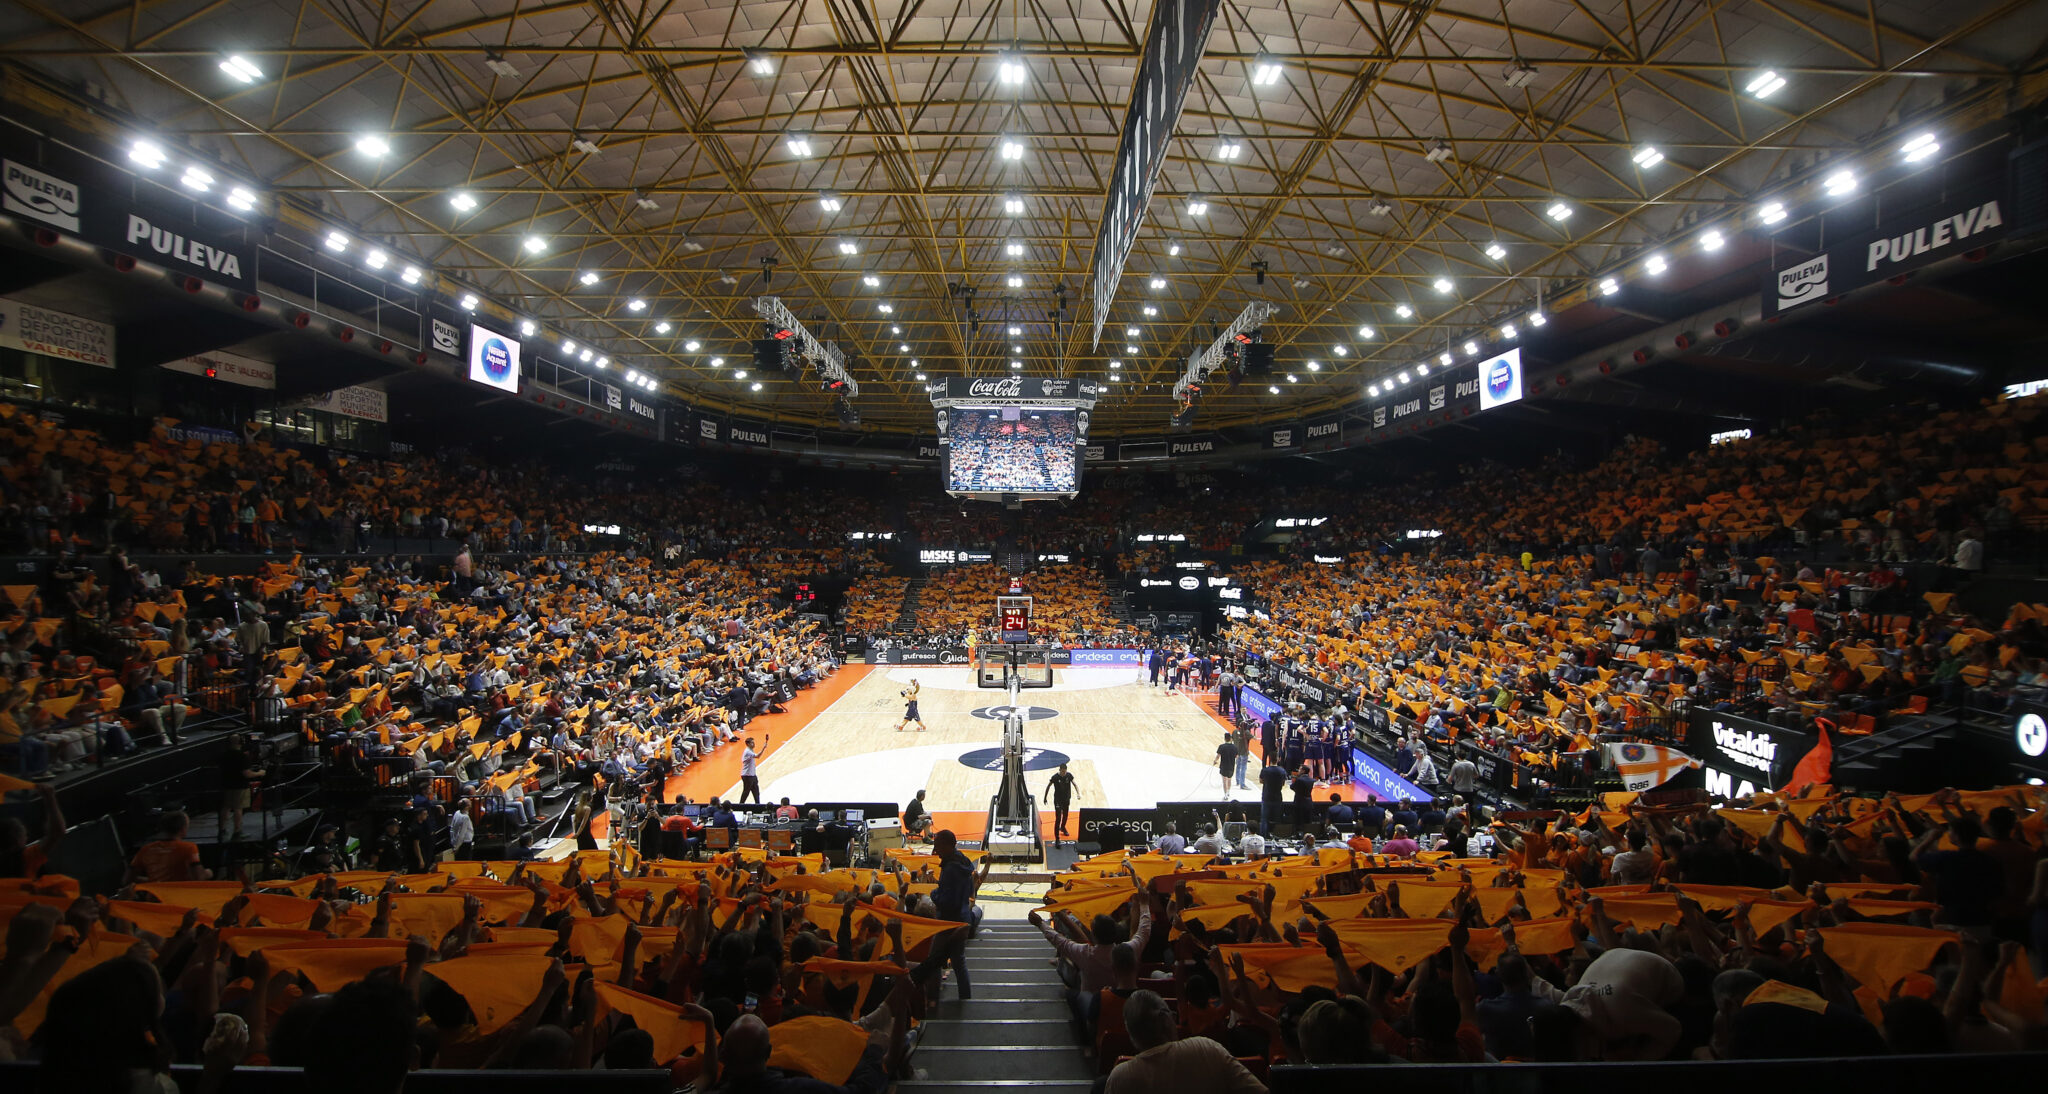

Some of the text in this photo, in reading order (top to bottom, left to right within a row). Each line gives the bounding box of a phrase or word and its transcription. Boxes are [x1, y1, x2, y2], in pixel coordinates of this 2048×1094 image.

[8, 166, 75, 203] PULEVA
[1867, 200, 2002, 271] PULEVA
[127, 213, 242, 279] PULEVA
[1781, 262, 1824, 287] PULEVA
[20, 318, 106, 346] DEPORTIVA
[435, 323, 458, 340] PULEVA
[20, 330, 107, 357] MUNICIPAL
[22, 340, 108, 365] VALENCIA
[225, 363, 237, 373] DE
[239, 365, 273, 381] VALENCIA
[969, 378, 1023, 396] Coca-Cola
[341, 407, 383, 420] VALENCIA
[630, 397, 655, 420] PULEVA
[1393, 398, 1420, 419] PULEVA
[731, 428, 767, 444] PULEVA
[1307, 422, 1338, 438] PULEVA
[1173, 441, 1213, 453] PULEVA
[920, 550, 955, 560] IMSKE
[1006, 617, 1024, 630] 24
[902, 653, 936, 661] gufresco
[1075, 652, 1113, 661] endesa
[1299, 678, 1322, 702] Esfuerzo
[1310, 724, 1318, 733] 15
[1085, 818, 1152, 832] endesa
